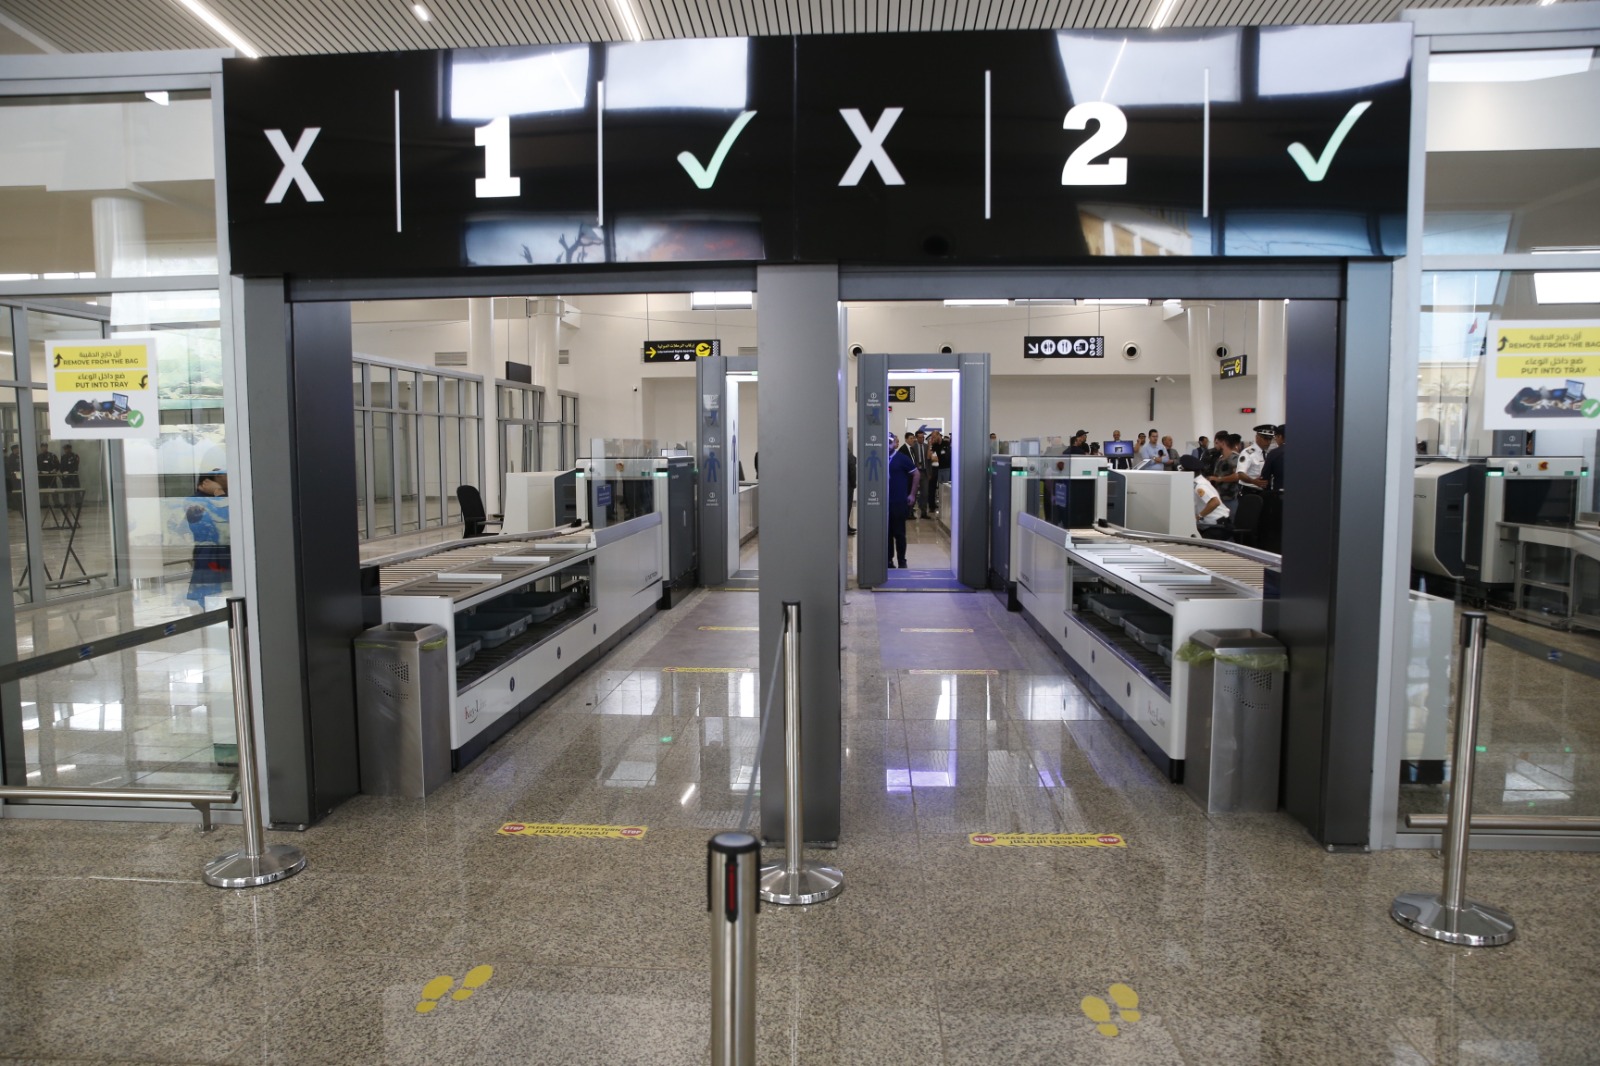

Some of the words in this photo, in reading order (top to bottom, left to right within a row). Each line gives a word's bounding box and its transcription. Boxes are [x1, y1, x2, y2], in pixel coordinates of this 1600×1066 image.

[264, 127, 324, 204] X
[474, 115, 521, 198] 1
[838, 107, 905, 186] X
[1061, 101, 1128, 186] 2
[1525, 358, 1548, 366] الوعاء
[1550, 358, 1568, 366] داخل
